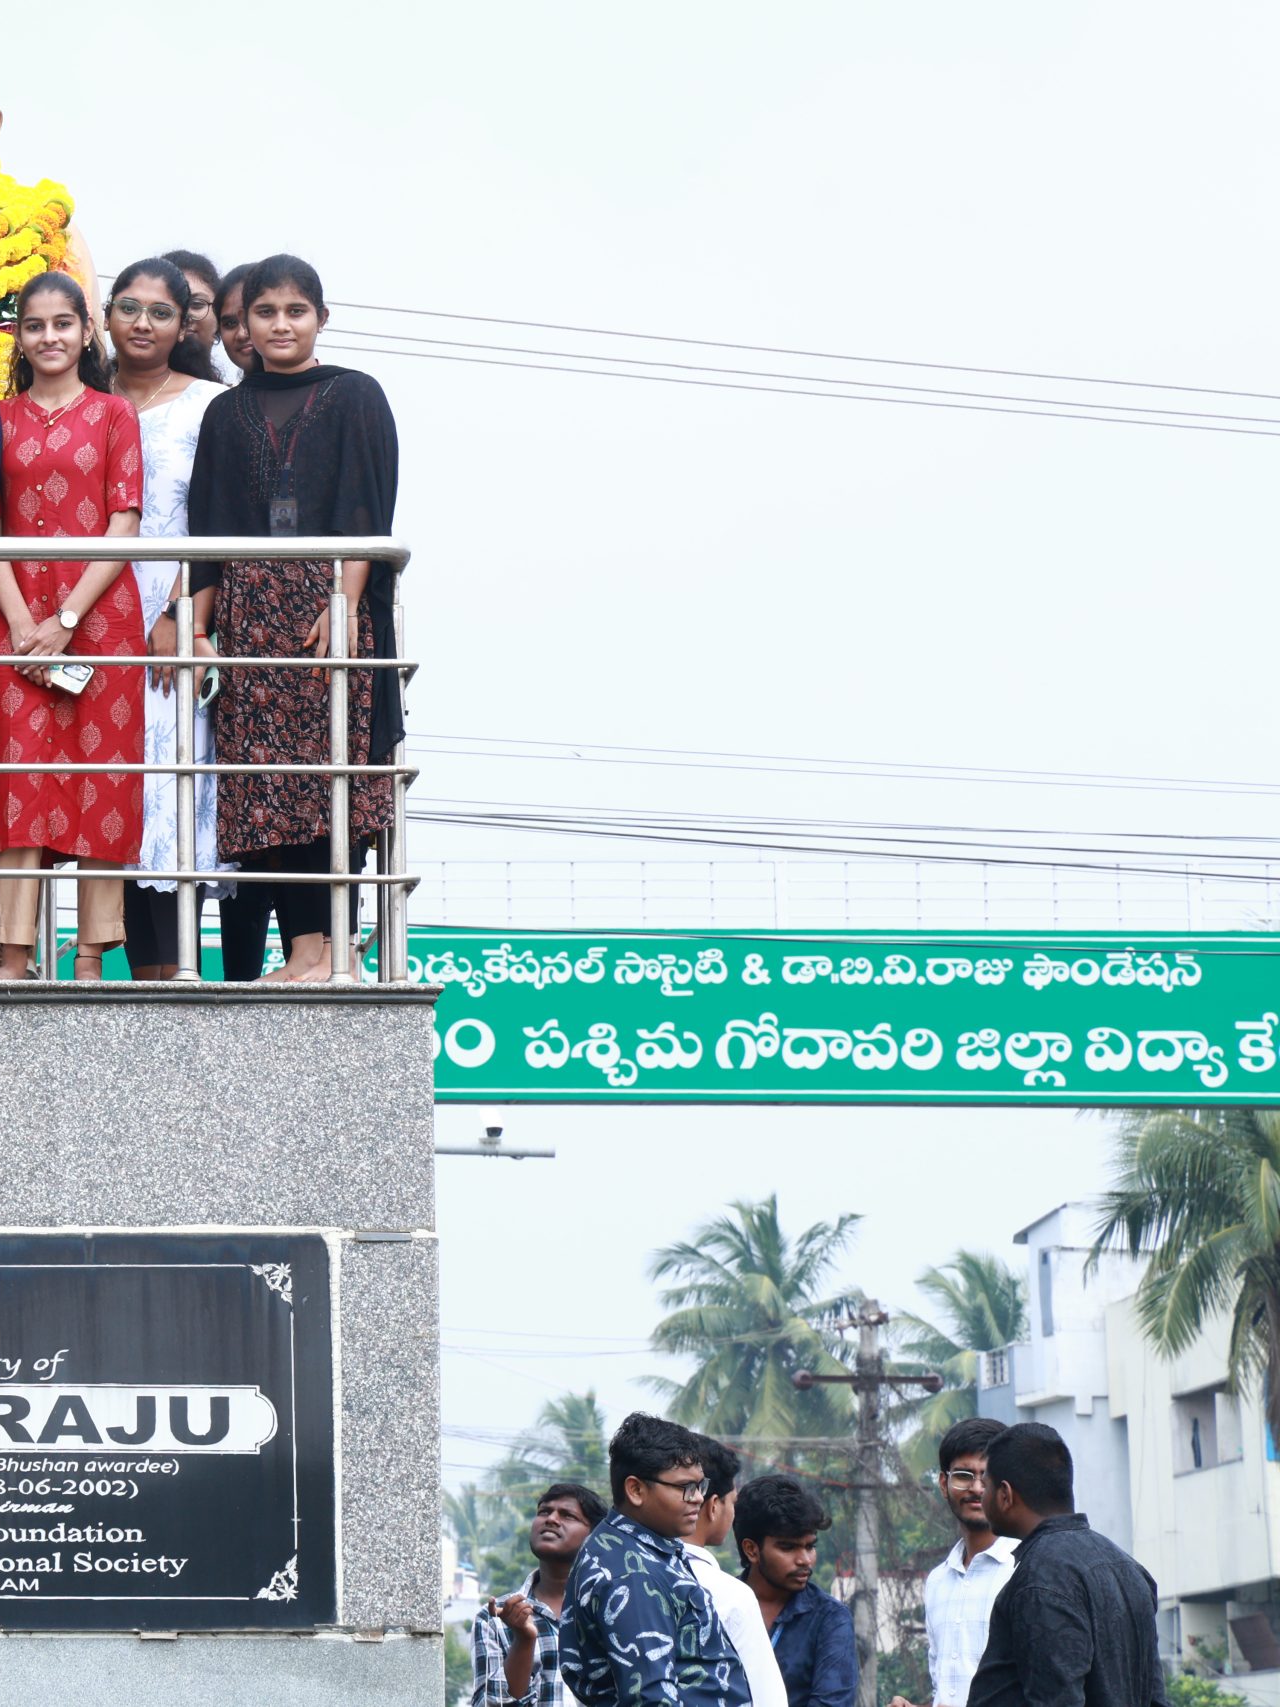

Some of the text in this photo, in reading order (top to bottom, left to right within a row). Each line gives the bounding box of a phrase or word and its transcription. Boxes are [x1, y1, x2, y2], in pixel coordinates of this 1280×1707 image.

[741, 953, 772, 986] &
[522, 1018, 703, 1087] పశ్చిమ
[715, 1011, 943, 1071] గోదావరి
[955, 1027, 1073, 1087] జిల్లా
[1084, 1026, 1229, 1088] విద్యా
[1234, 1011, 1280, 1073] కే
[32, 1349, 65, 1379] of
[83, 1457, 180, 1476] awardee)
[73, 1551, 189, 1578] Society
